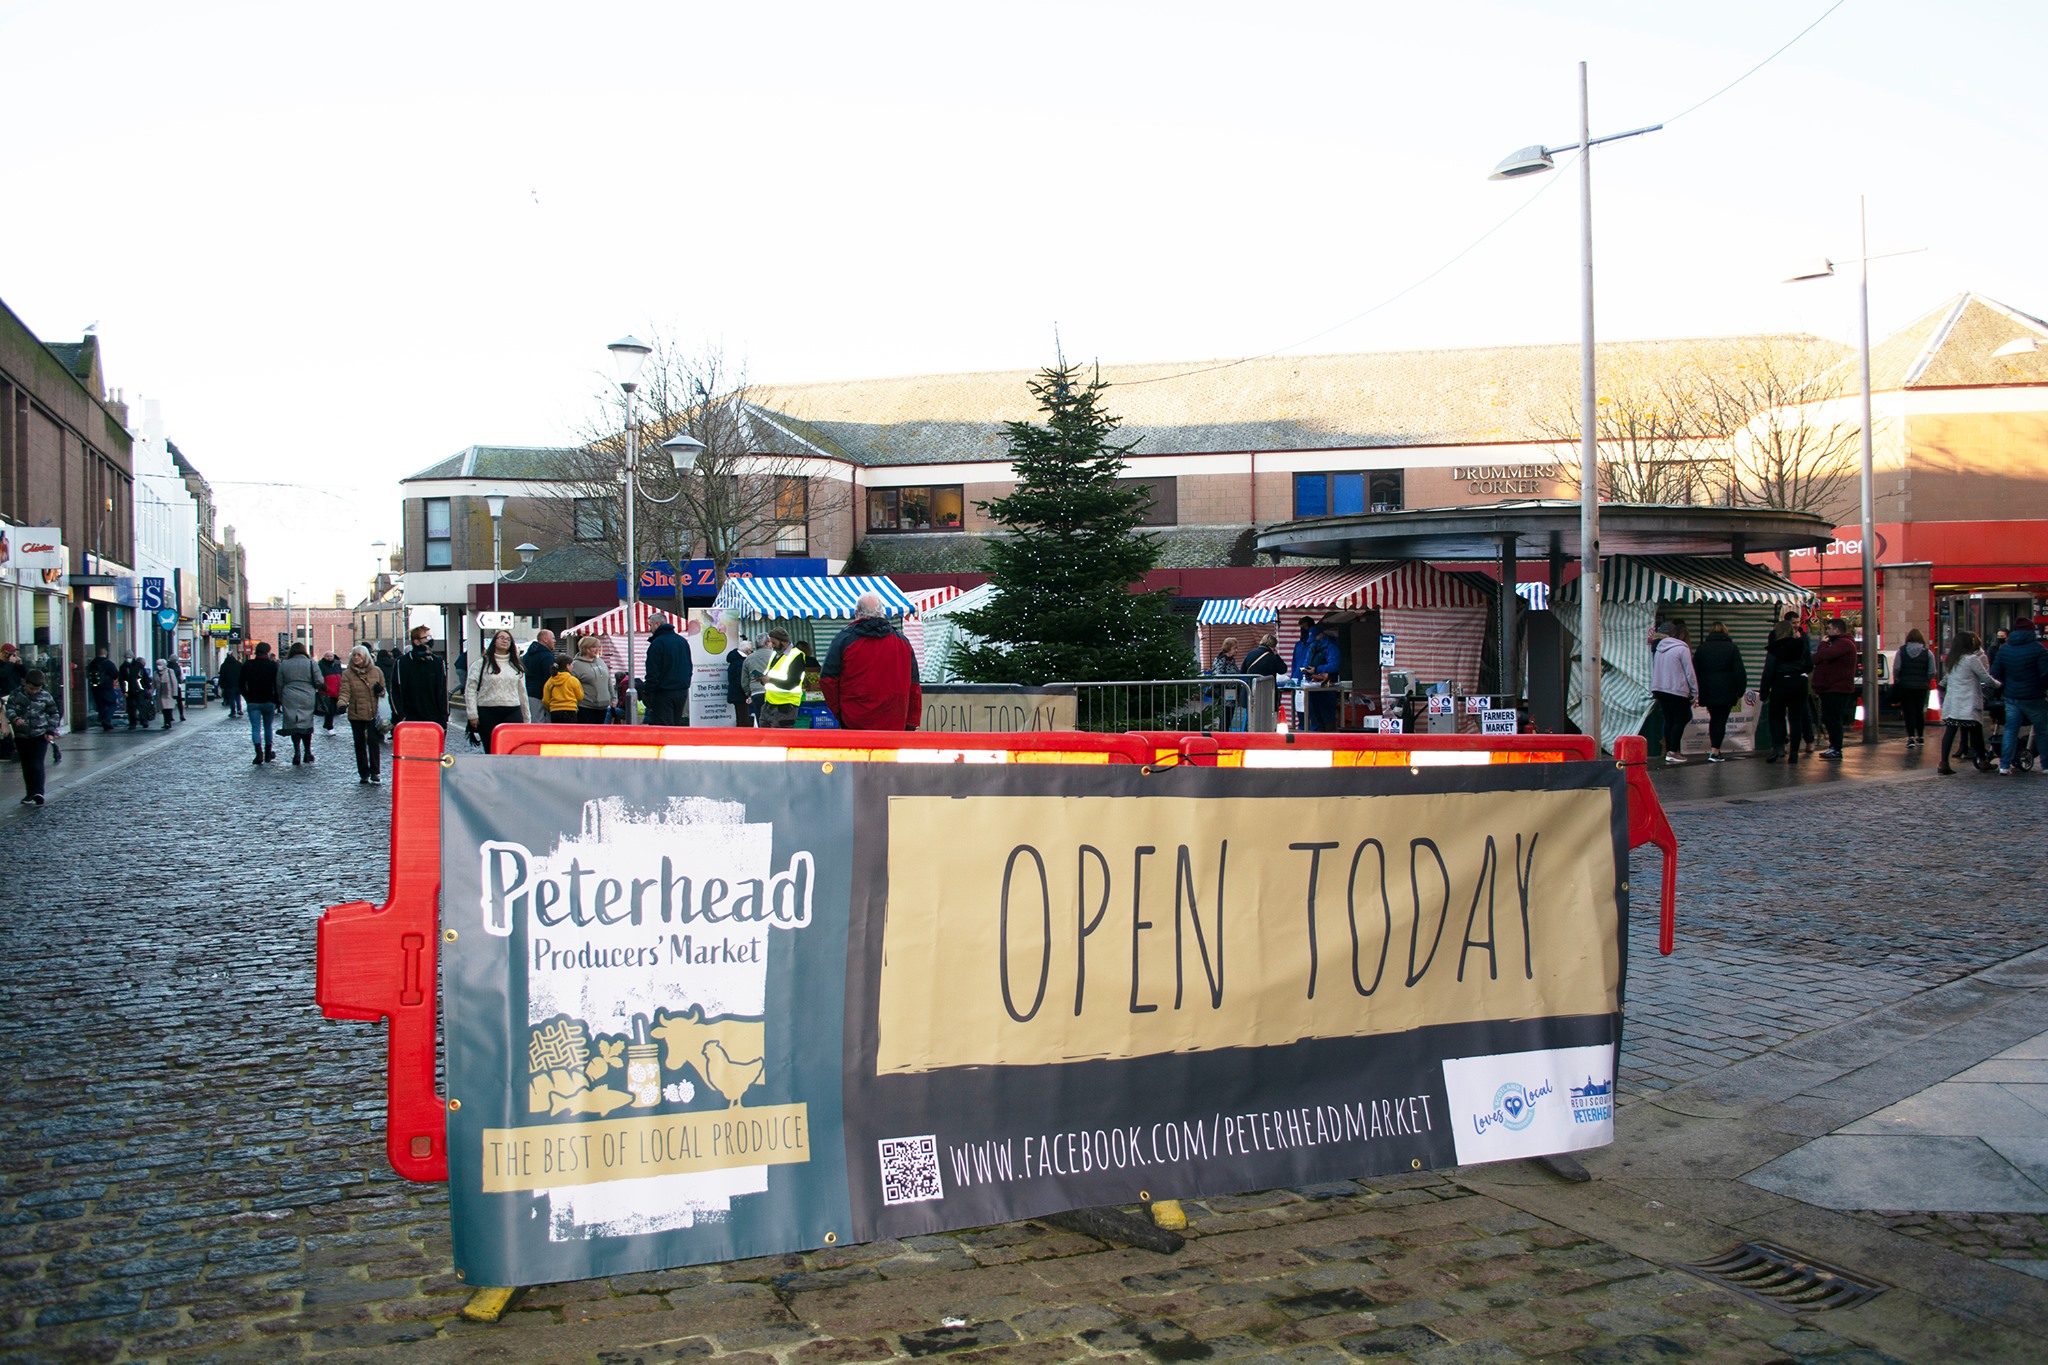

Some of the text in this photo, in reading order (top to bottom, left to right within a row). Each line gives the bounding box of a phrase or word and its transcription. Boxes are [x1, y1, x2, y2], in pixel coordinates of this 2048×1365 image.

[1453, 464, 1556, 480] DRUMMERS
[1467, 480, 1541, 495] CORNER
[145, 586, 162, 609] S
[926, 704, 1056, 732] OPEN TODAY
[1483, 711, 1515, 720] FARMERS
[1485, 723, 1514, 732] MARKET
[488, 848, 807, 928] Peterhead
[1000, 832, 1539, 1022] OPEN TODAY
[669, 934, 762, 965] Market
[1473, 1109, 1504, 1135] Loves
[1523, 1079, 1553, 1108] Local
[490, 1115, 804, 1177] THE BEST OF LOCAL PRODUCE
[949, 1095, 1432, 1187] WWW.FACEBOOK.COM/PETERHEADMARKET
